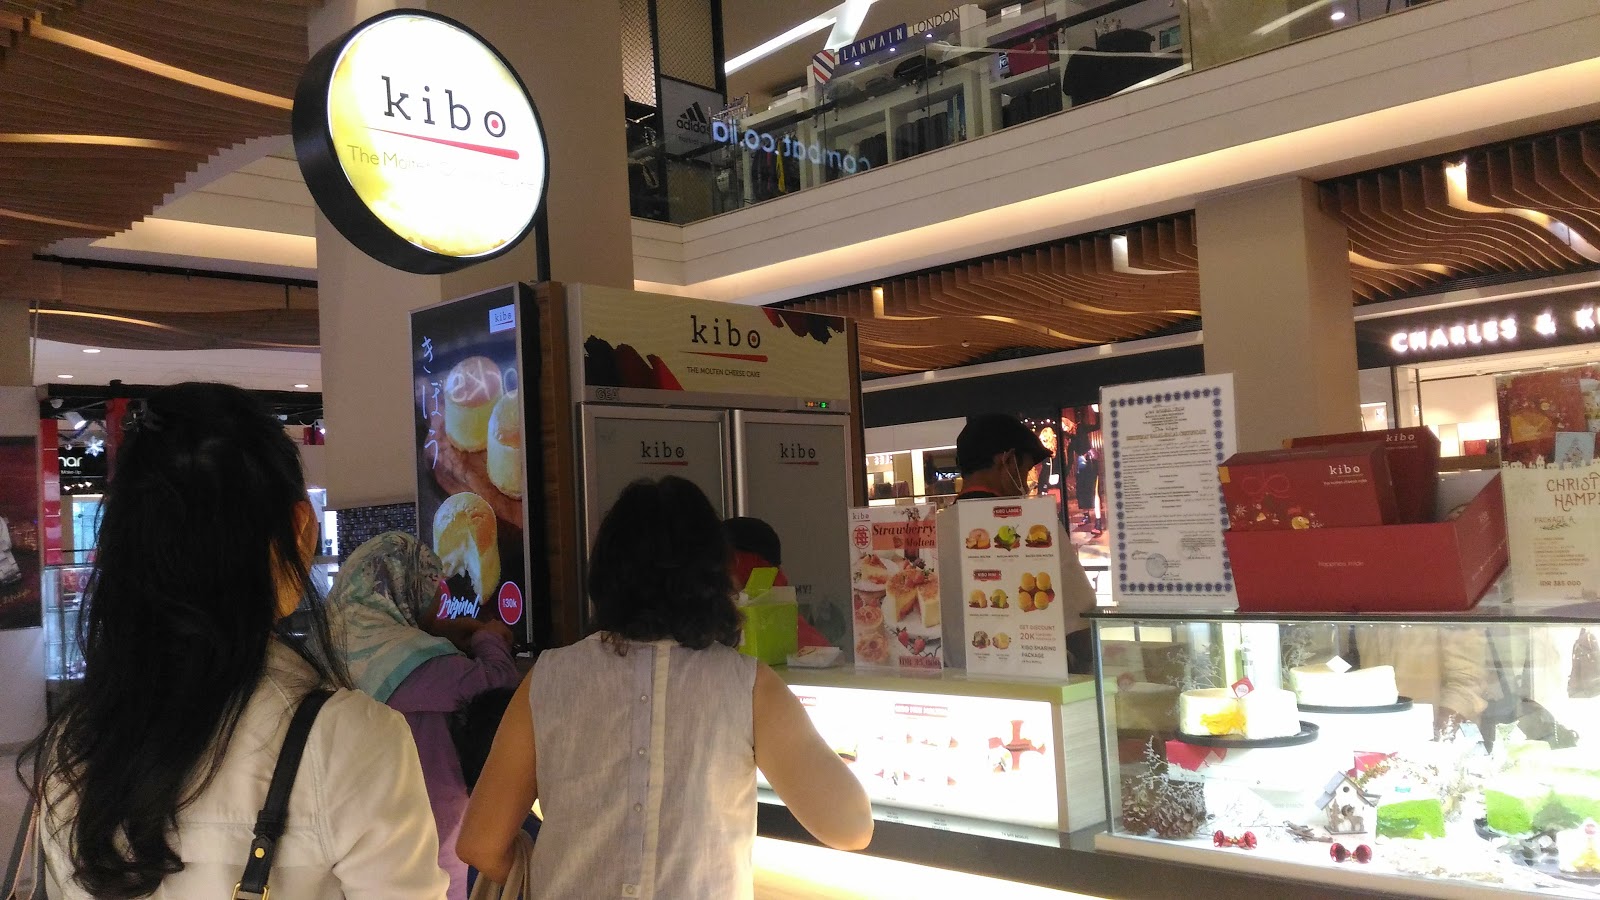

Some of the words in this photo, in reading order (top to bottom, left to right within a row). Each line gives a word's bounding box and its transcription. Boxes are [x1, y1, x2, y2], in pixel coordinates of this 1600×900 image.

[842, 27, 903, 61] LANWAIN
[912, 8, 960, 35] LONDON
[381, 75, 506, 138] kibo
[347, 144, 380, 165] The
[690, 314, 761, 349] kibo
[1390, 317, 1518, 353] CHARLES
[1535, 312, 1557, 335] &
[686, 366, 699, 374] THE
[700, 367, 724, 376] MOLTEN
[725, 368, 746, 377] CHEESE
[746, 370, 761, 378] CAKE
[1385, 432, 1415, 443] kibo
[640, 441, 685, 459] kibo
[779, 443, 816, 459] kibo
[1328, 464, 1361, 475] kibo
[852, 512, 870, 520] kibo
[872, 523, 936, 536] Strawberry
[905, 537, 935, 547] Molten
[1020, 632, 1035, 640] 20K
